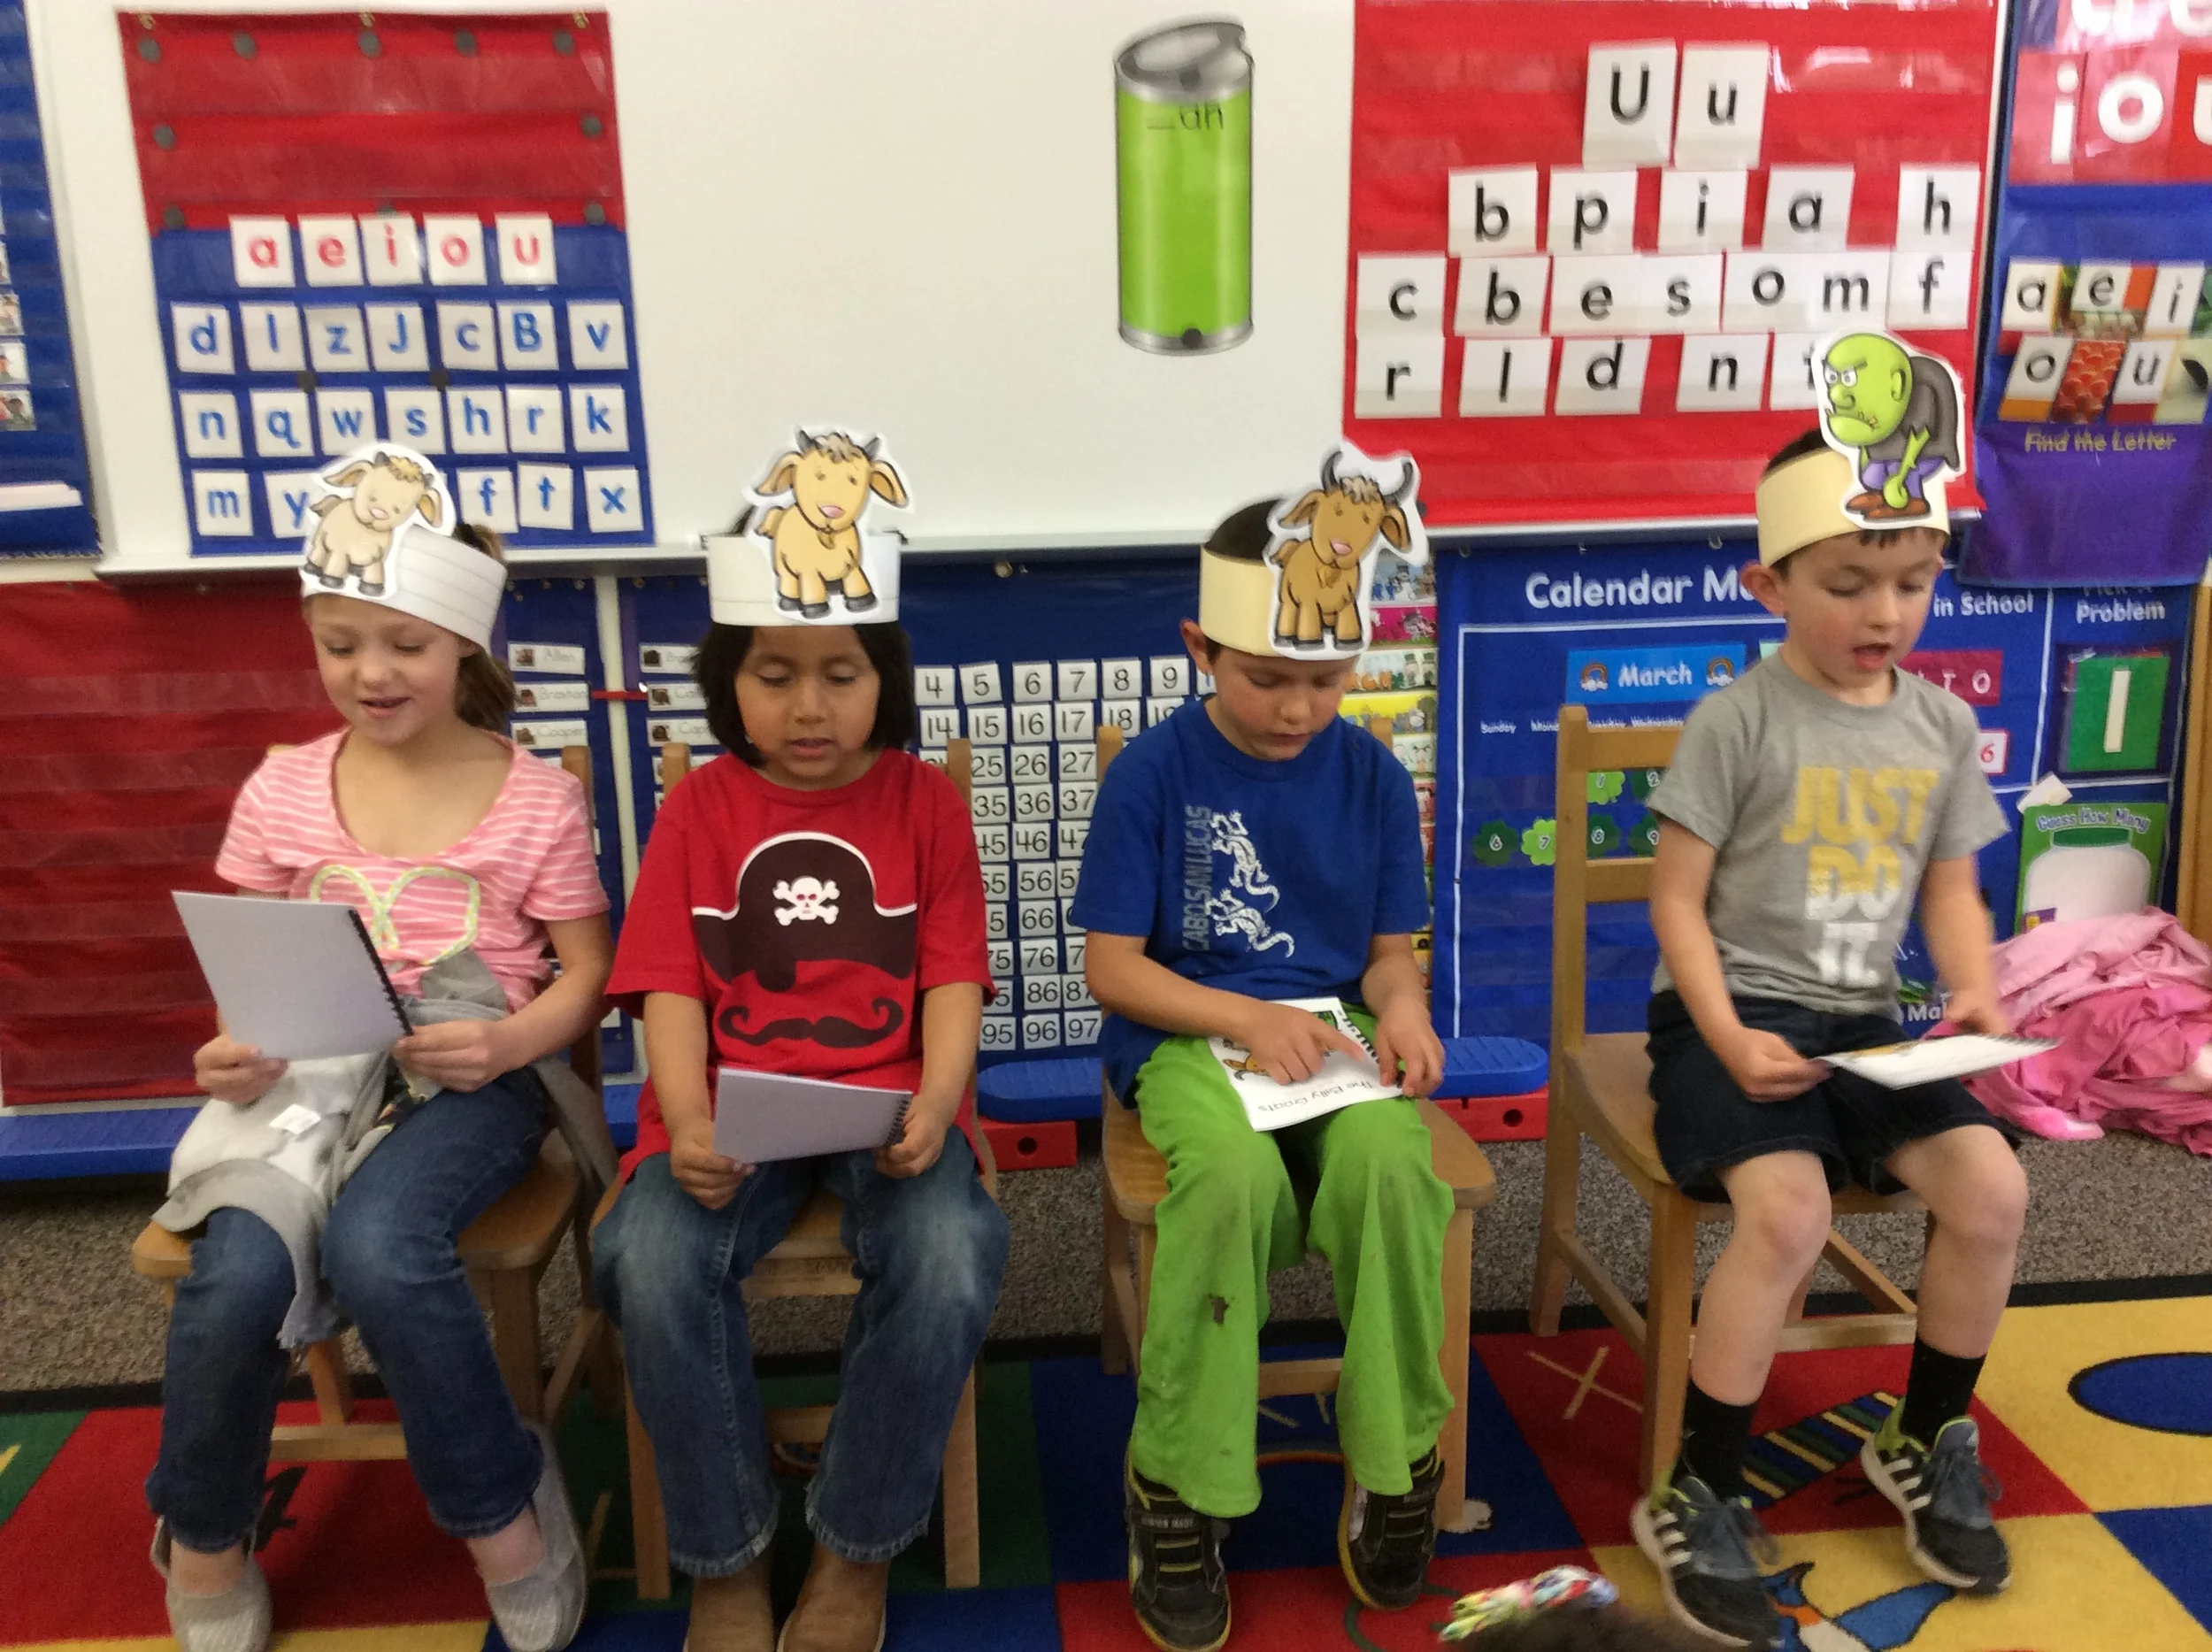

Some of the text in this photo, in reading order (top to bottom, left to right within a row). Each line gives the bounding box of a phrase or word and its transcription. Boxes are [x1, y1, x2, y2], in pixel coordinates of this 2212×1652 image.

[1609, 62, 1737, 125] U u
[2050, 60, 2079, 165] i
[2097, 72, 2164, 143] o
[1474, 175, 1951, 250] b p i a h
[249, 226, 540, 268] a e i o u
[1388, 258, 1944, 325] c b e s o m f
[2016, 273, 2183, 324] a e i
[189, 313, 218, 356] d
[326, 321, 349, 353] z
[390, 313, 409, 354] J
[515, 312, 541, 352] B
[1386, 357, 1410, 401] r
[1586, 339, 1623, 391] d
[1709, 353, 1737, 391] n
[2132, 355, 2160, 386] u
[199, 407, 226, 441] n
[268, 406, 299, 448] q
[465, 397, 490, 436] h
[526, 400, 543, 435] r
[2024, 426, 2177, 453] Find the Letter
[207, 488, 241, 519] m
[283, 488, 309, 528] y
[478, 477, 497, 517] f
[538, 477, 556, 512] t
[1525, 568, 1694, 609] Calendar
[1933, 591, 2034, 617] in School
[2076, 598, 2165, 624] Problem
[926, 673, 942, 699] 4
[973, 672, 990, 696] 5
[1025, 671, 1041, 695] 6
[1070, 668, 1087, 693] 7
[1114, 667, 1130, 691] 8
[1162, 665, 1178, 689] 9
[1618, 662, 1693, 688] March
[927, 716, 953, 739] 14
[975, 713, 1000, 738] 15
[1020, 711, 1044, 735] 16
[1062, 710, 1087, 734] 17
[1109, 707, 1133, 731] 18
[1480, 720, 1517, 734] Sunday
[972, 750, 1095, 778] 25 26 27
[1980, 742, 1994, 764] 6
[974, 789, 1094, 818] 35 36 37
[1780, 766, 1939, 845] JUST
[2037, 806, 2151, 834] Guess How Many
[1016, 830, 1048, 853] 46
[1020, 870, 1053, 892] 56
[1806, 845, 1901, 920] DO
[1022, 908, 1054, 930] 66
[1024, 947, 1055, 968] 76
[1027, 981, 1058, 1003] 86
[982, 1018, 1098, 1044] 95 96 97
[1257, 1080, 1373, 1112] The Billy Goats
